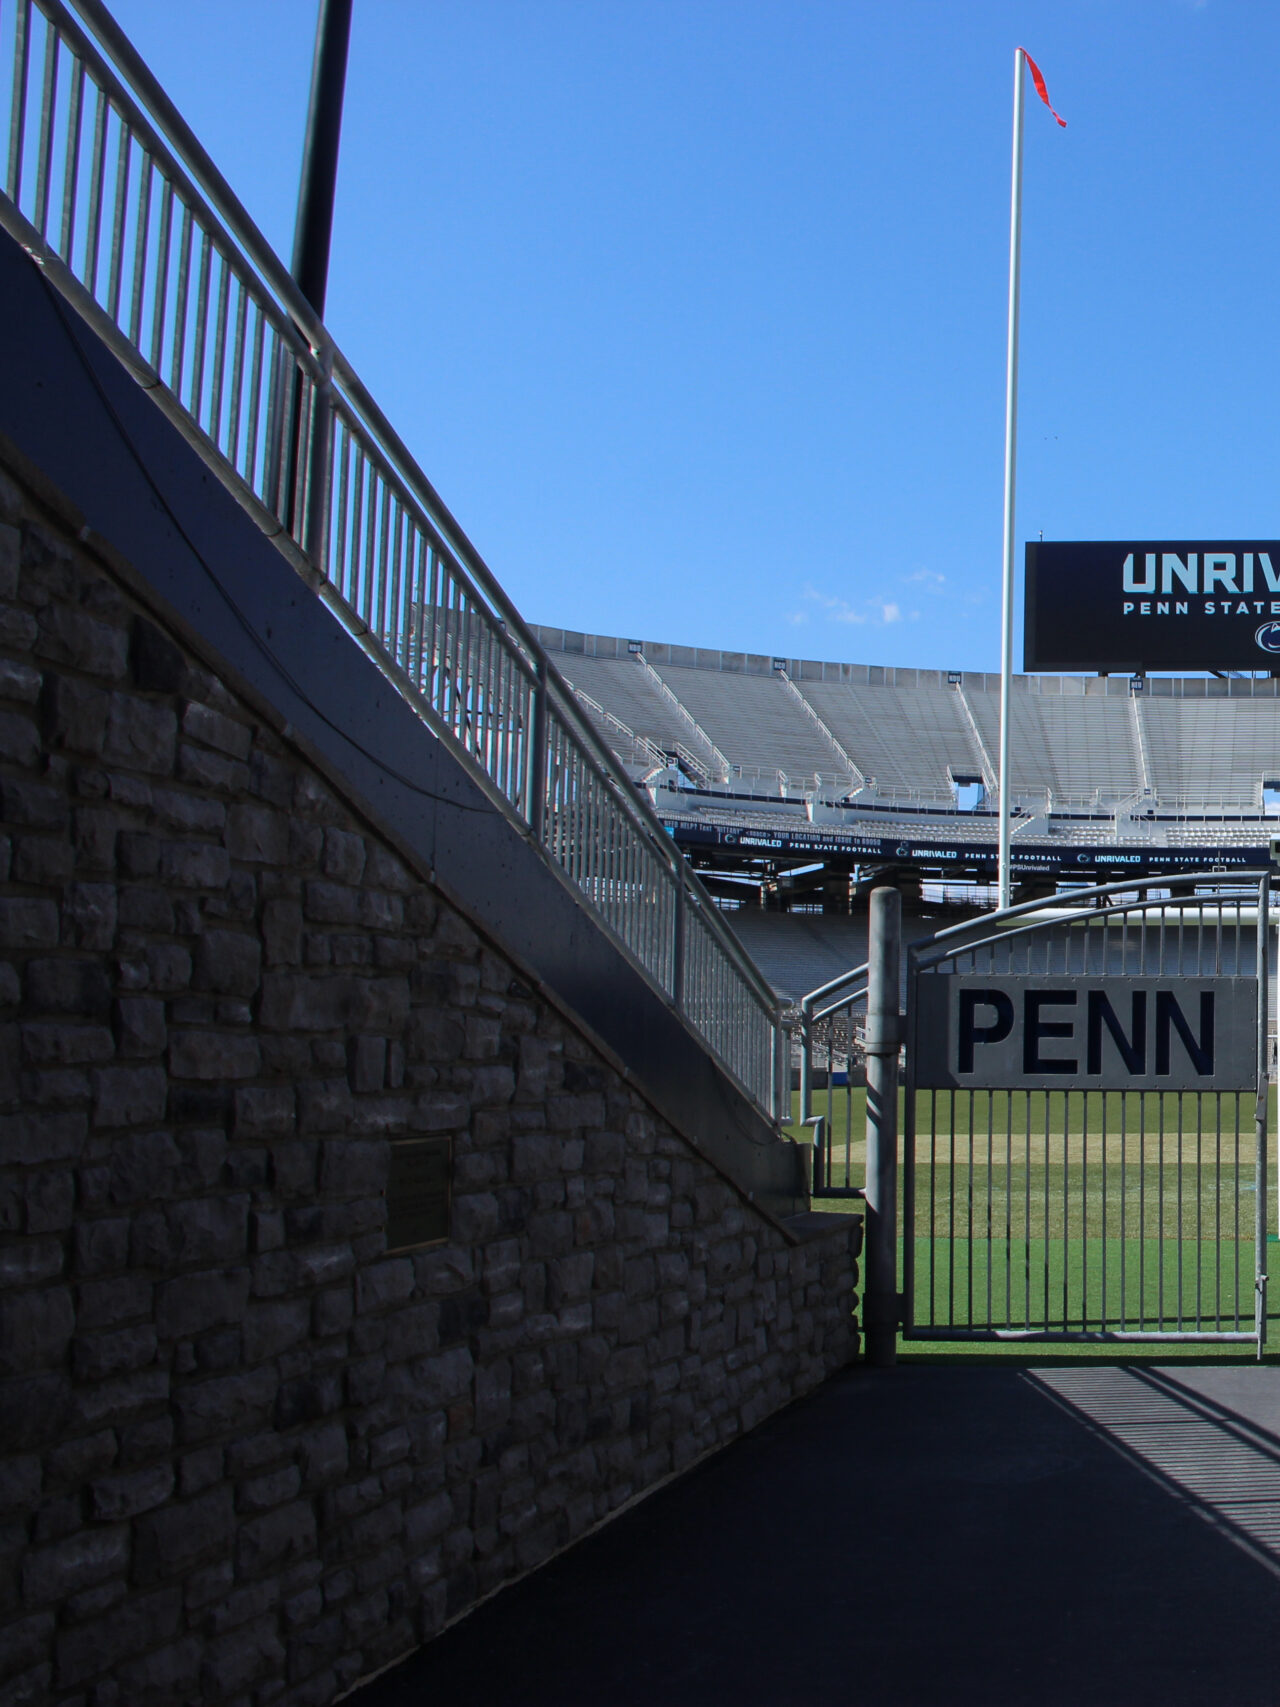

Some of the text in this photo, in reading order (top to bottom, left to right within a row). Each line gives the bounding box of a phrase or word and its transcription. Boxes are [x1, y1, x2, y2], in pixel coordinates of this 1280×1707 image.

[1122, 601, 1189, 615] PENN
[740, 836, 782, 847] UNRIVALED
[814, 843, 838, 851] STATE
[841, 846, 882, 854] FOOTBALL
[911, 849, 958, 859] UNRIVALED
[1094, 855, 1141, 863] UNRIVALED
[958, 988, 1216, 1076] PENN
